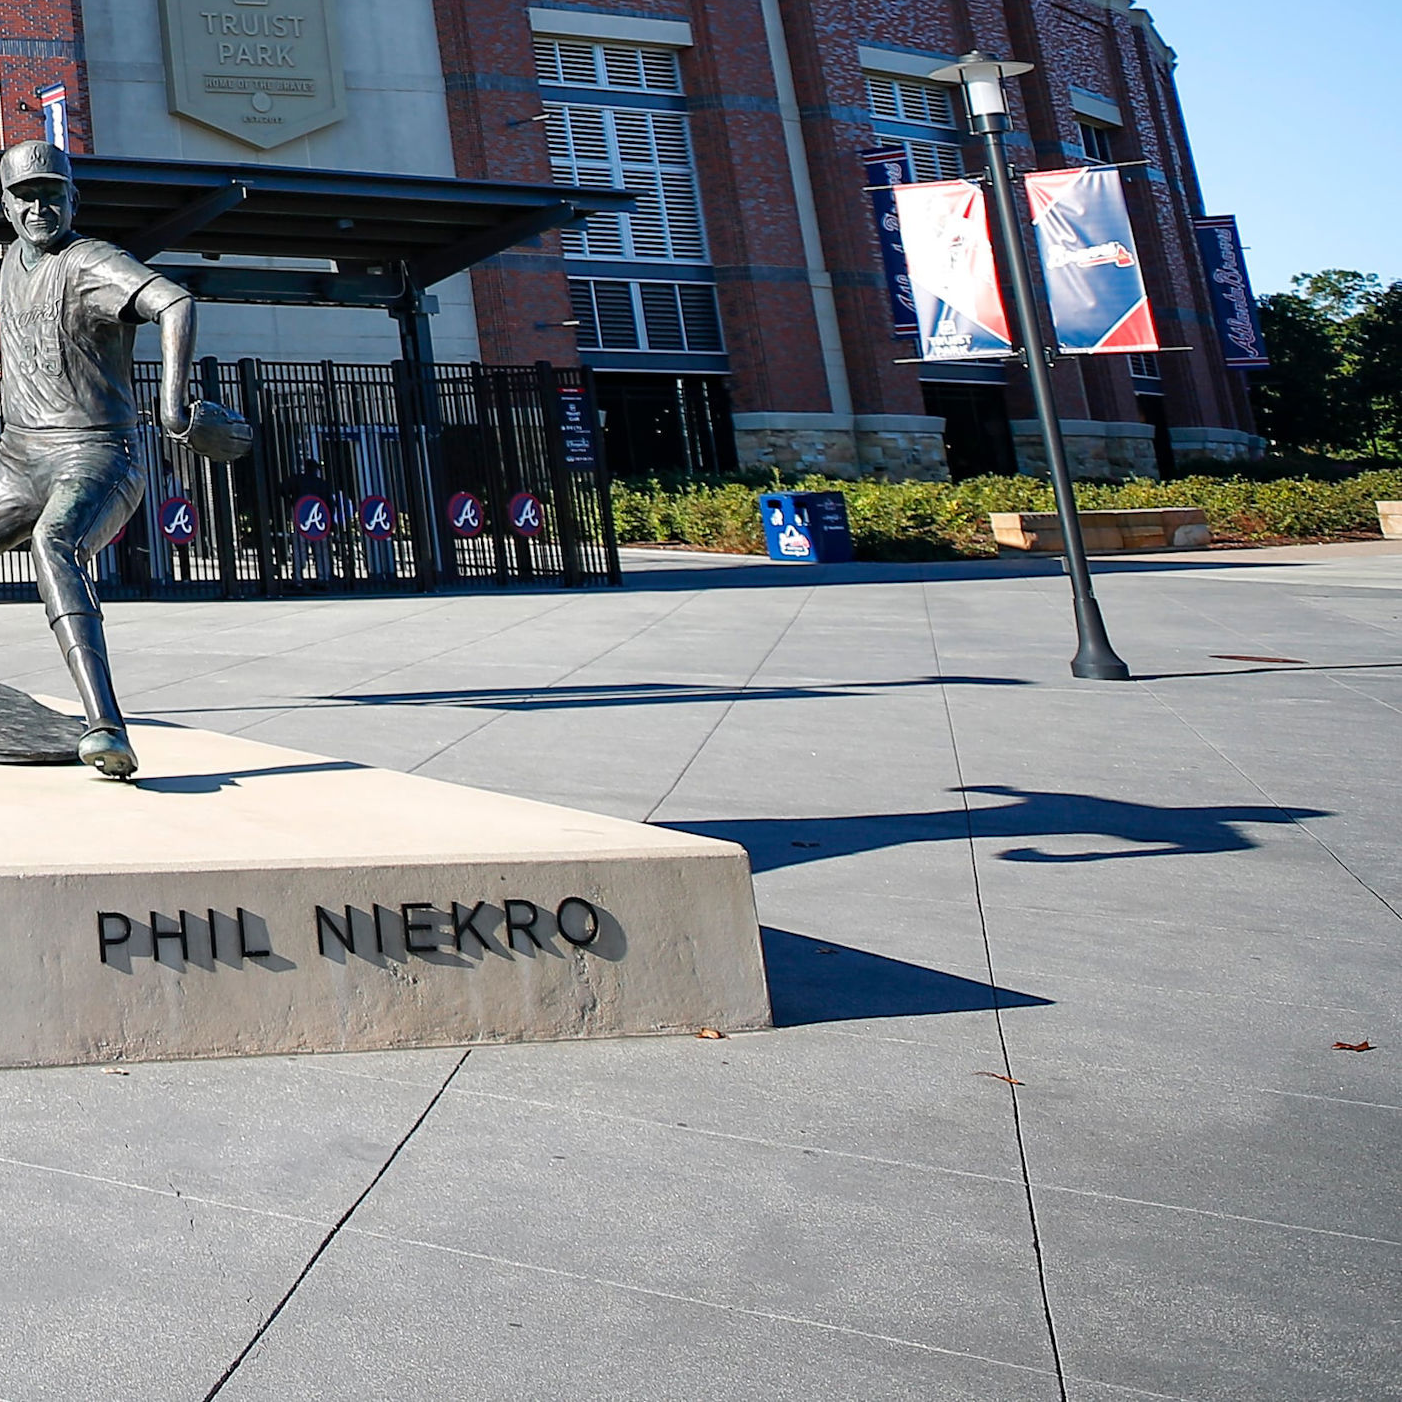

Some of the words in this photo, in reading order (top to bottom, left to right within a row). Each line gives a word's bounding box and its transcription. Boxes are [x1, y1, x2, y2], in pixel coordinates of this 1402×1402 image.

[200, 11, 305, 39] TRUIST
[218, 42, 296, 69] PARK
[97, 907, 270, 964] PHIL
[315, 896, 599, 956] NIEKRO
